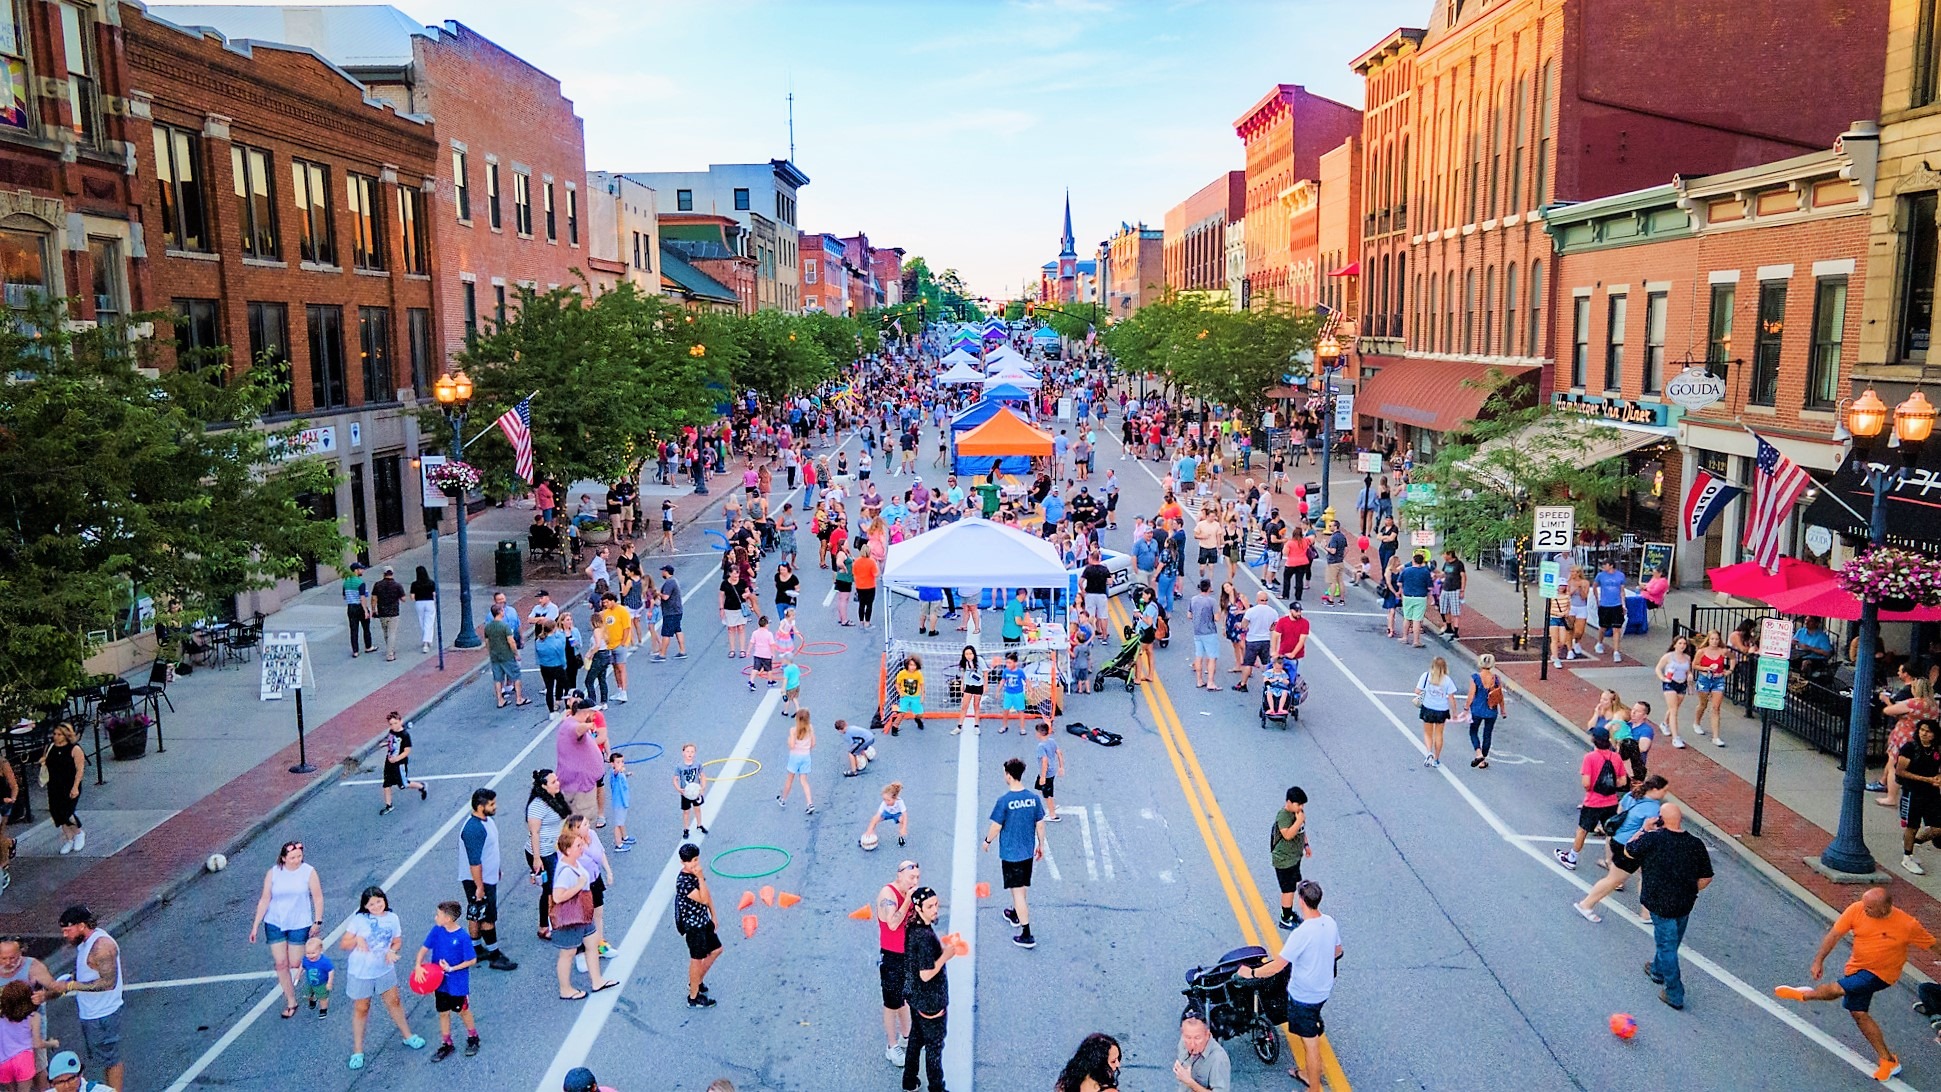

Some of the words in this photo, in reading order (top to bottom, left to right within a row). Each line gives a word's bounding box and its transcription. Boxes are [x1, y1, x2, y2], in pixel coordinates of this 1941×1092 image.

[1670, 384, 1720, 396] GOUDA
[1622, 401, 1651, 422] Diner
[1539, 511, 1570, 519] SPEED
[1538, 530, 1567, 546] 25
[1779, 623, 1790, 631] NO
[265, 645, 298, 653] CREATIVE
[264, 652, 302, 660] FOUNDATION
[265, 660, 299, 668] ARTWORK
[268, 669, 277, 677] ON
[279, 669, 297, 677] SALE
[266, 677, 286, 685] COME
[1008, 798, 1036, 810] COACH
